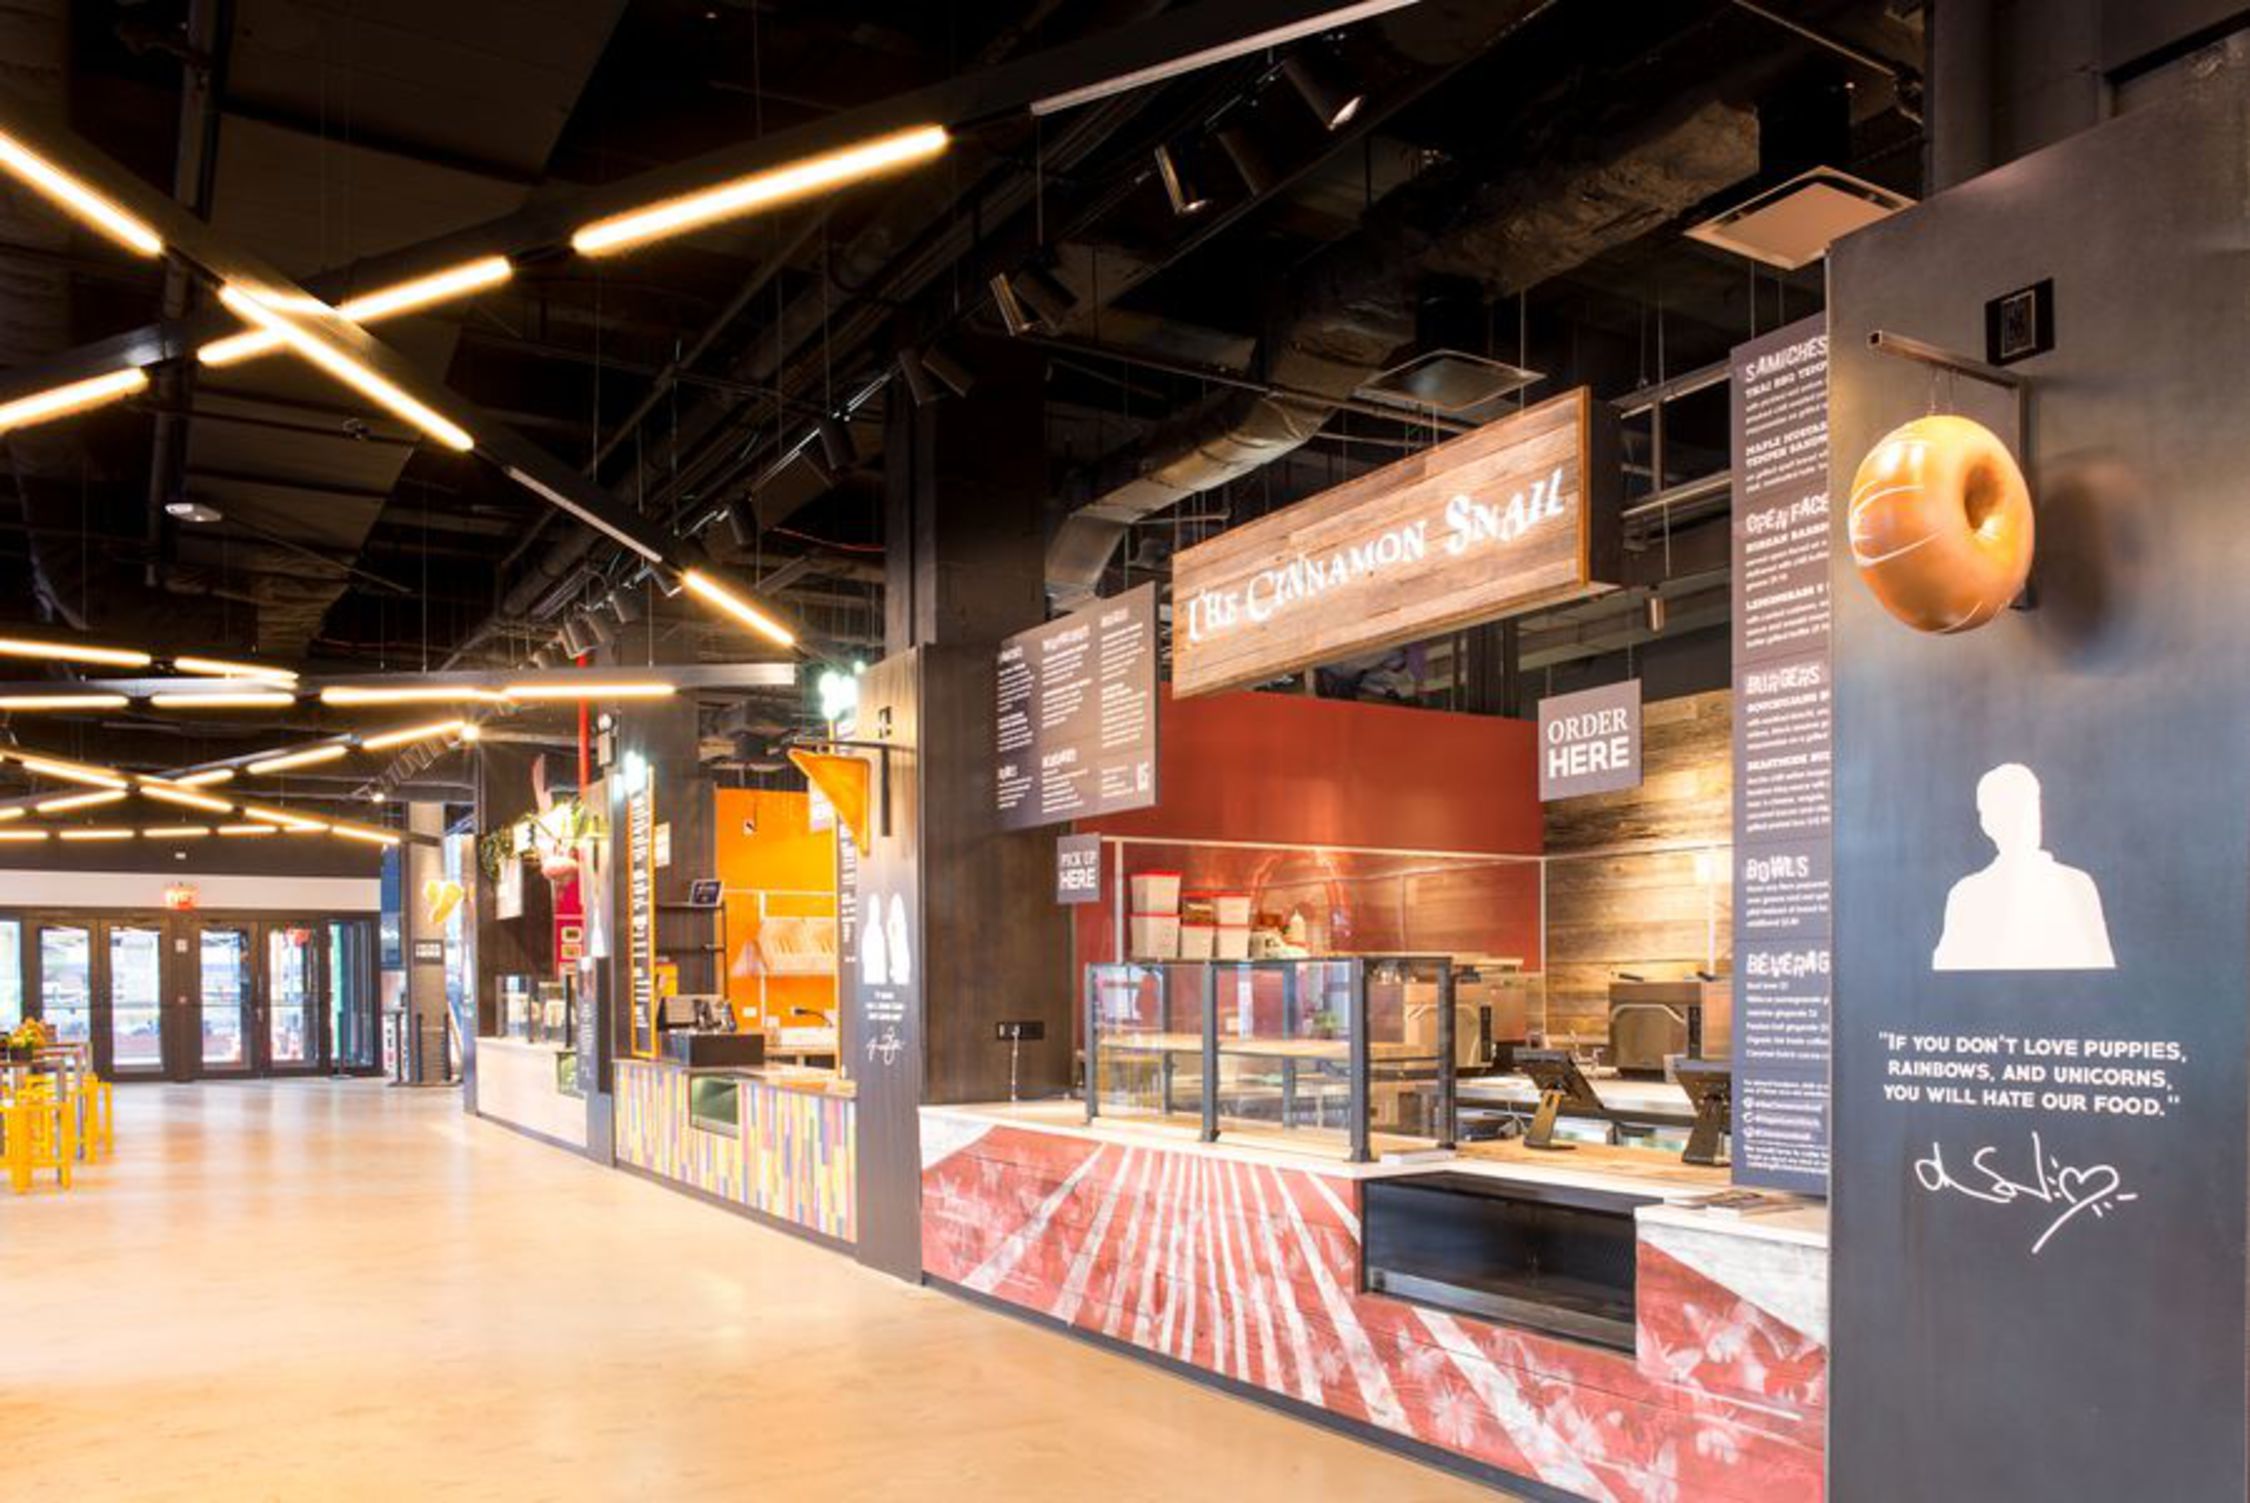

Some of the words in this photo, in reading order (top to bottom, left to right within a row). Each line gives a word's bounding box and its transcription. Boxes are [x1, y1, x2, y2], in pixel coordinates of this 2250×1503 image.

[1791, 491, 1830, 523] FACE
[1187, 588, 1238, 642] THE
[1247, 520, 1430, 623] CINNAMON
[1445, 467, 1568, 556] SNAIL
[1746, 664, 1821, 695] BURGERS
[1547, 707, 1629, 745] ORDER
[1548, 736, 1630, 779] HERE
[1060, 867, 1097, 890] HERE
[1746, 855, 1810, 883] BOWLS
[1746, 950, 1831, 978] BEVERAG
[1879, 1031, 1908, 1051] "IF
[1912, 1035, 1951, 1053] YOU
[1955, 1034, 2018, 1056] DON'T
[2024, 1038, 2079, 1058] LOVE
[2084, 1040, 2187, 1063] PUPPIES,
[1888, 1058, 1996, 1083] RAINBOWS,
[2002, 1063, 2047, 1083] AND
[2053, 1066, 2173, 1091] UNICORNS,
[1883, 1084, 1921, 1102] YOU
[1926, 1086, 1978, 1105] WILL
[1982, 1088, 2036, 1109] HATE
[2041, 1092, 2087, 1112] OUR
[2094, 1094, 2180, 1117] FOOD."
